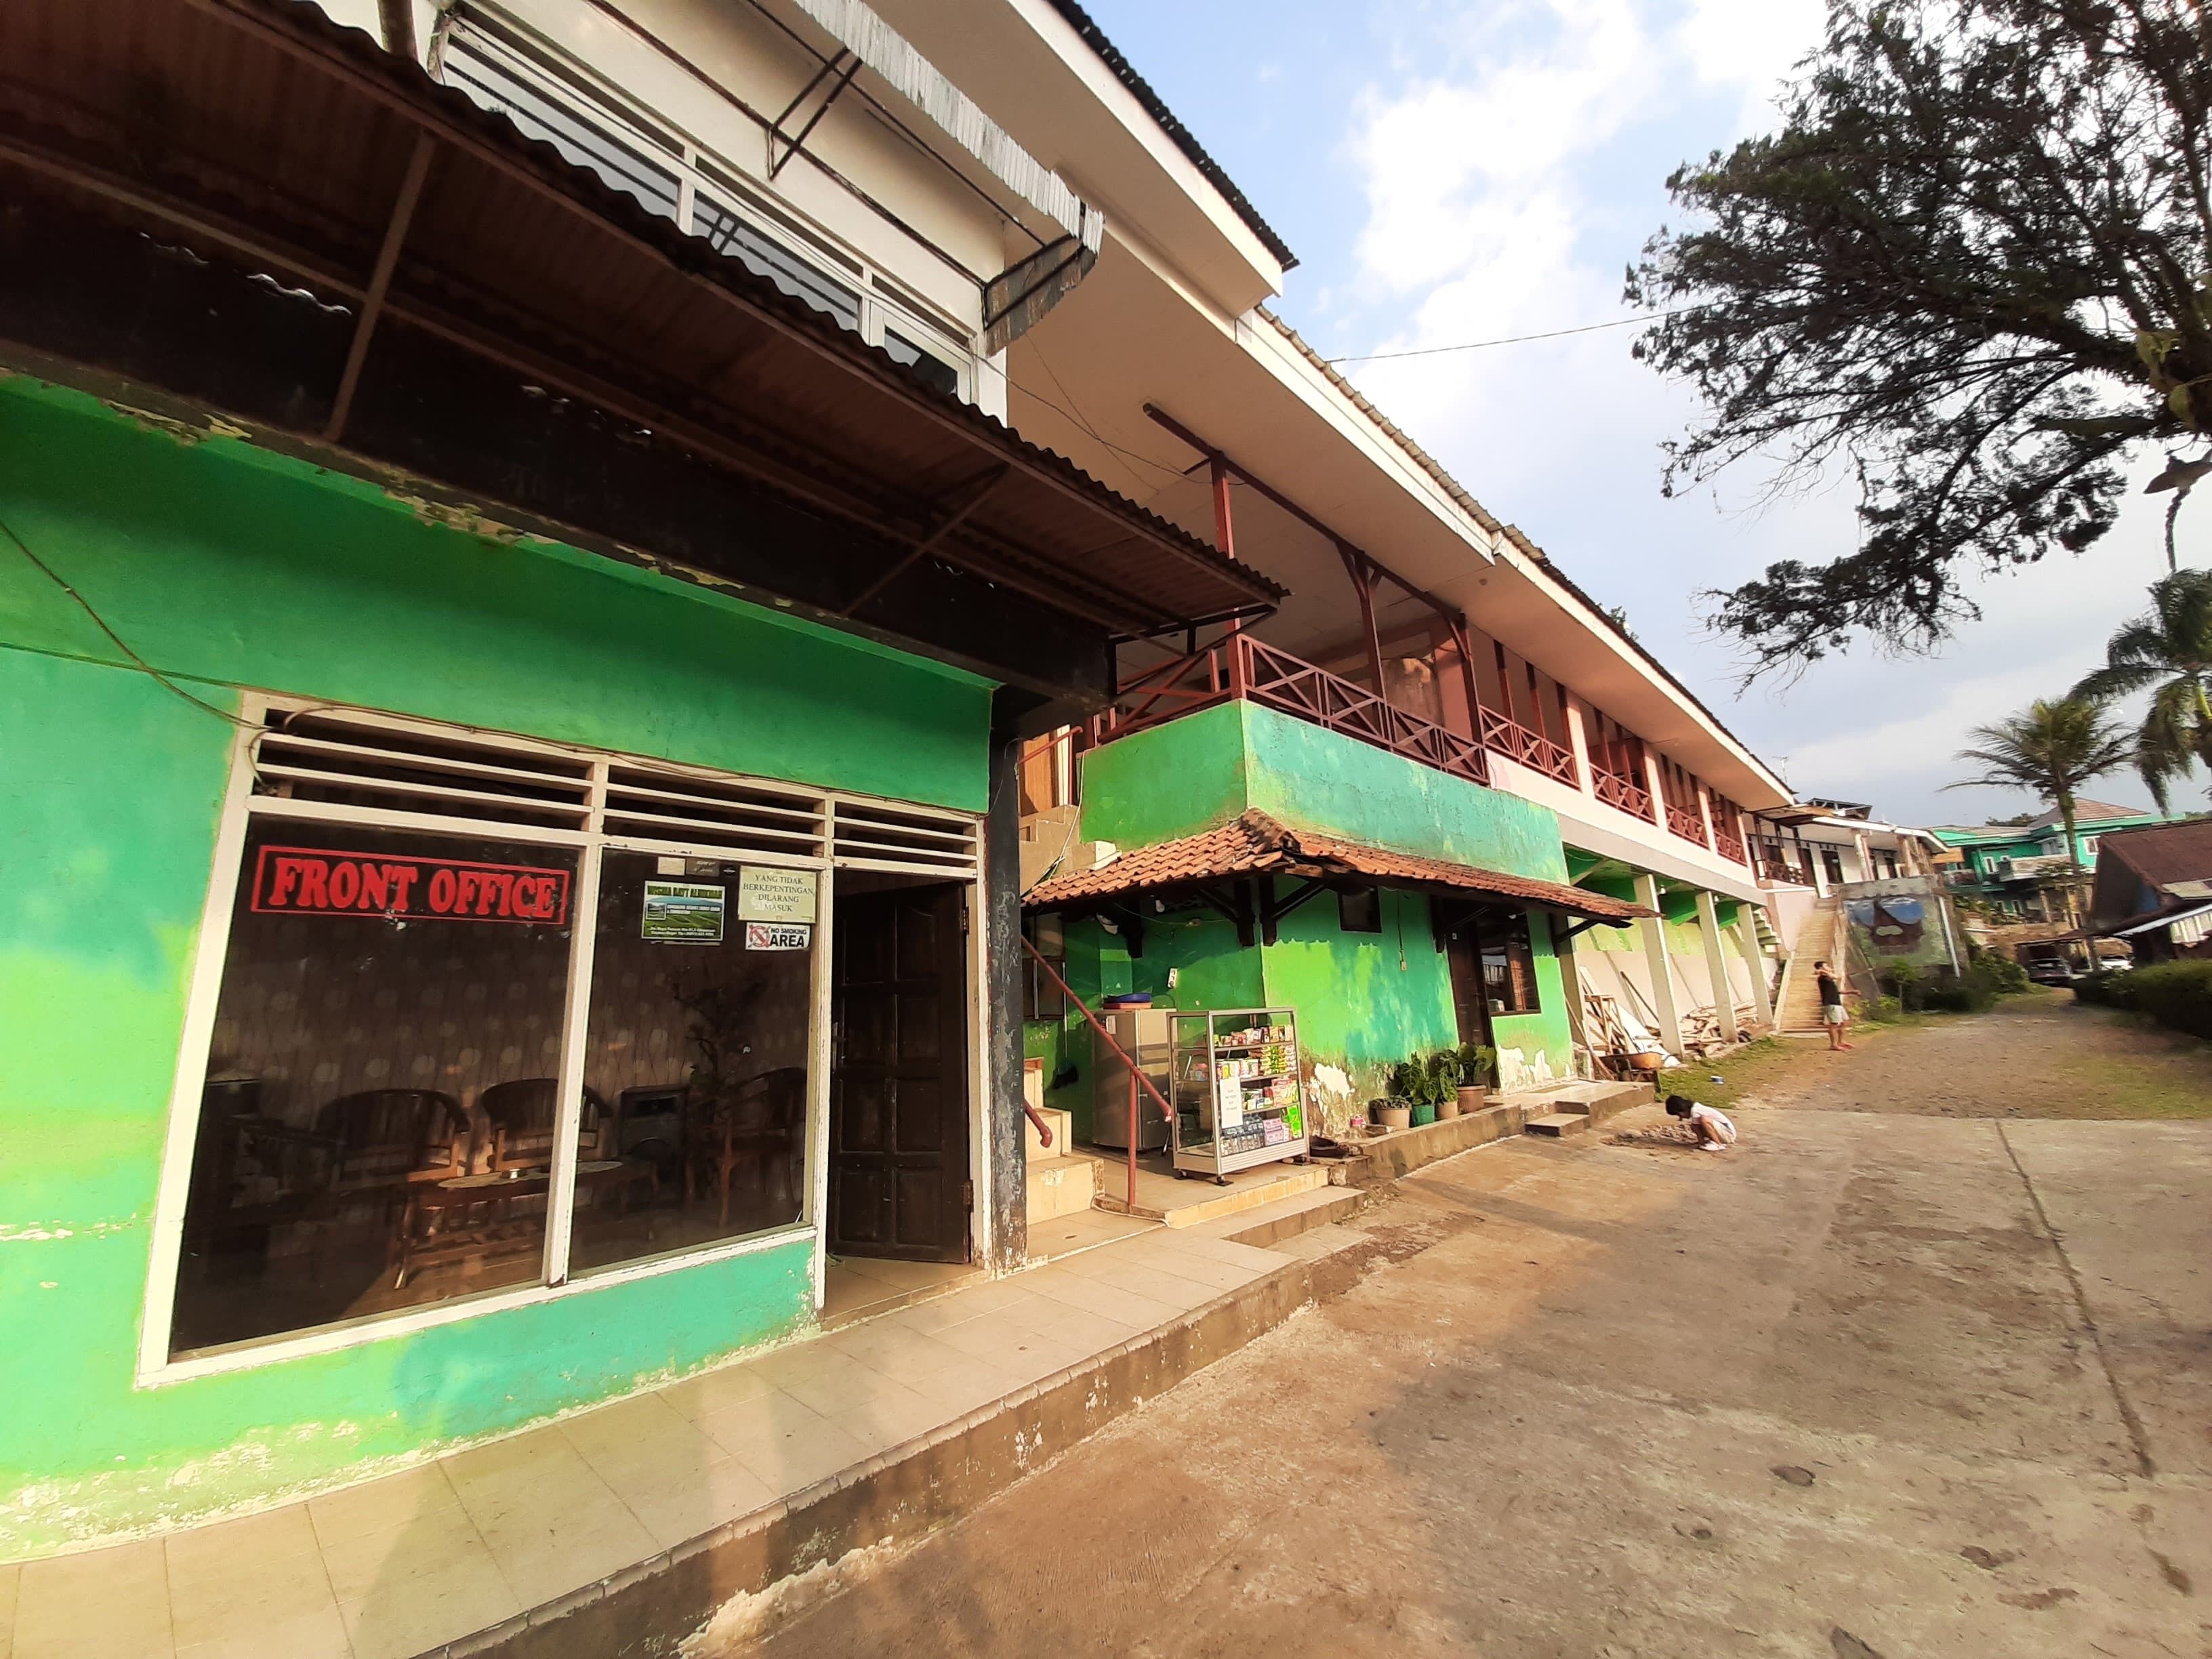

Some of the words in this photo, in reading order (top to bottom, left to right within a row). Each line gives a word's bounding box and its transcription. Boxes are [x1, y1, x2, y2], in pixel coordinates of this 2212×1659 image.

[755, 874, 778, 883] YANG
[780, 876, 803, 884] TIDAK
[268, 857, 418, 911] FRONT
[429, 868, 556, 918] OFFICE
[758, 894, 800, 903] DILARANG
[764, 903, 793, 912] MASUK
[770, 935, 804, 947] AREA
